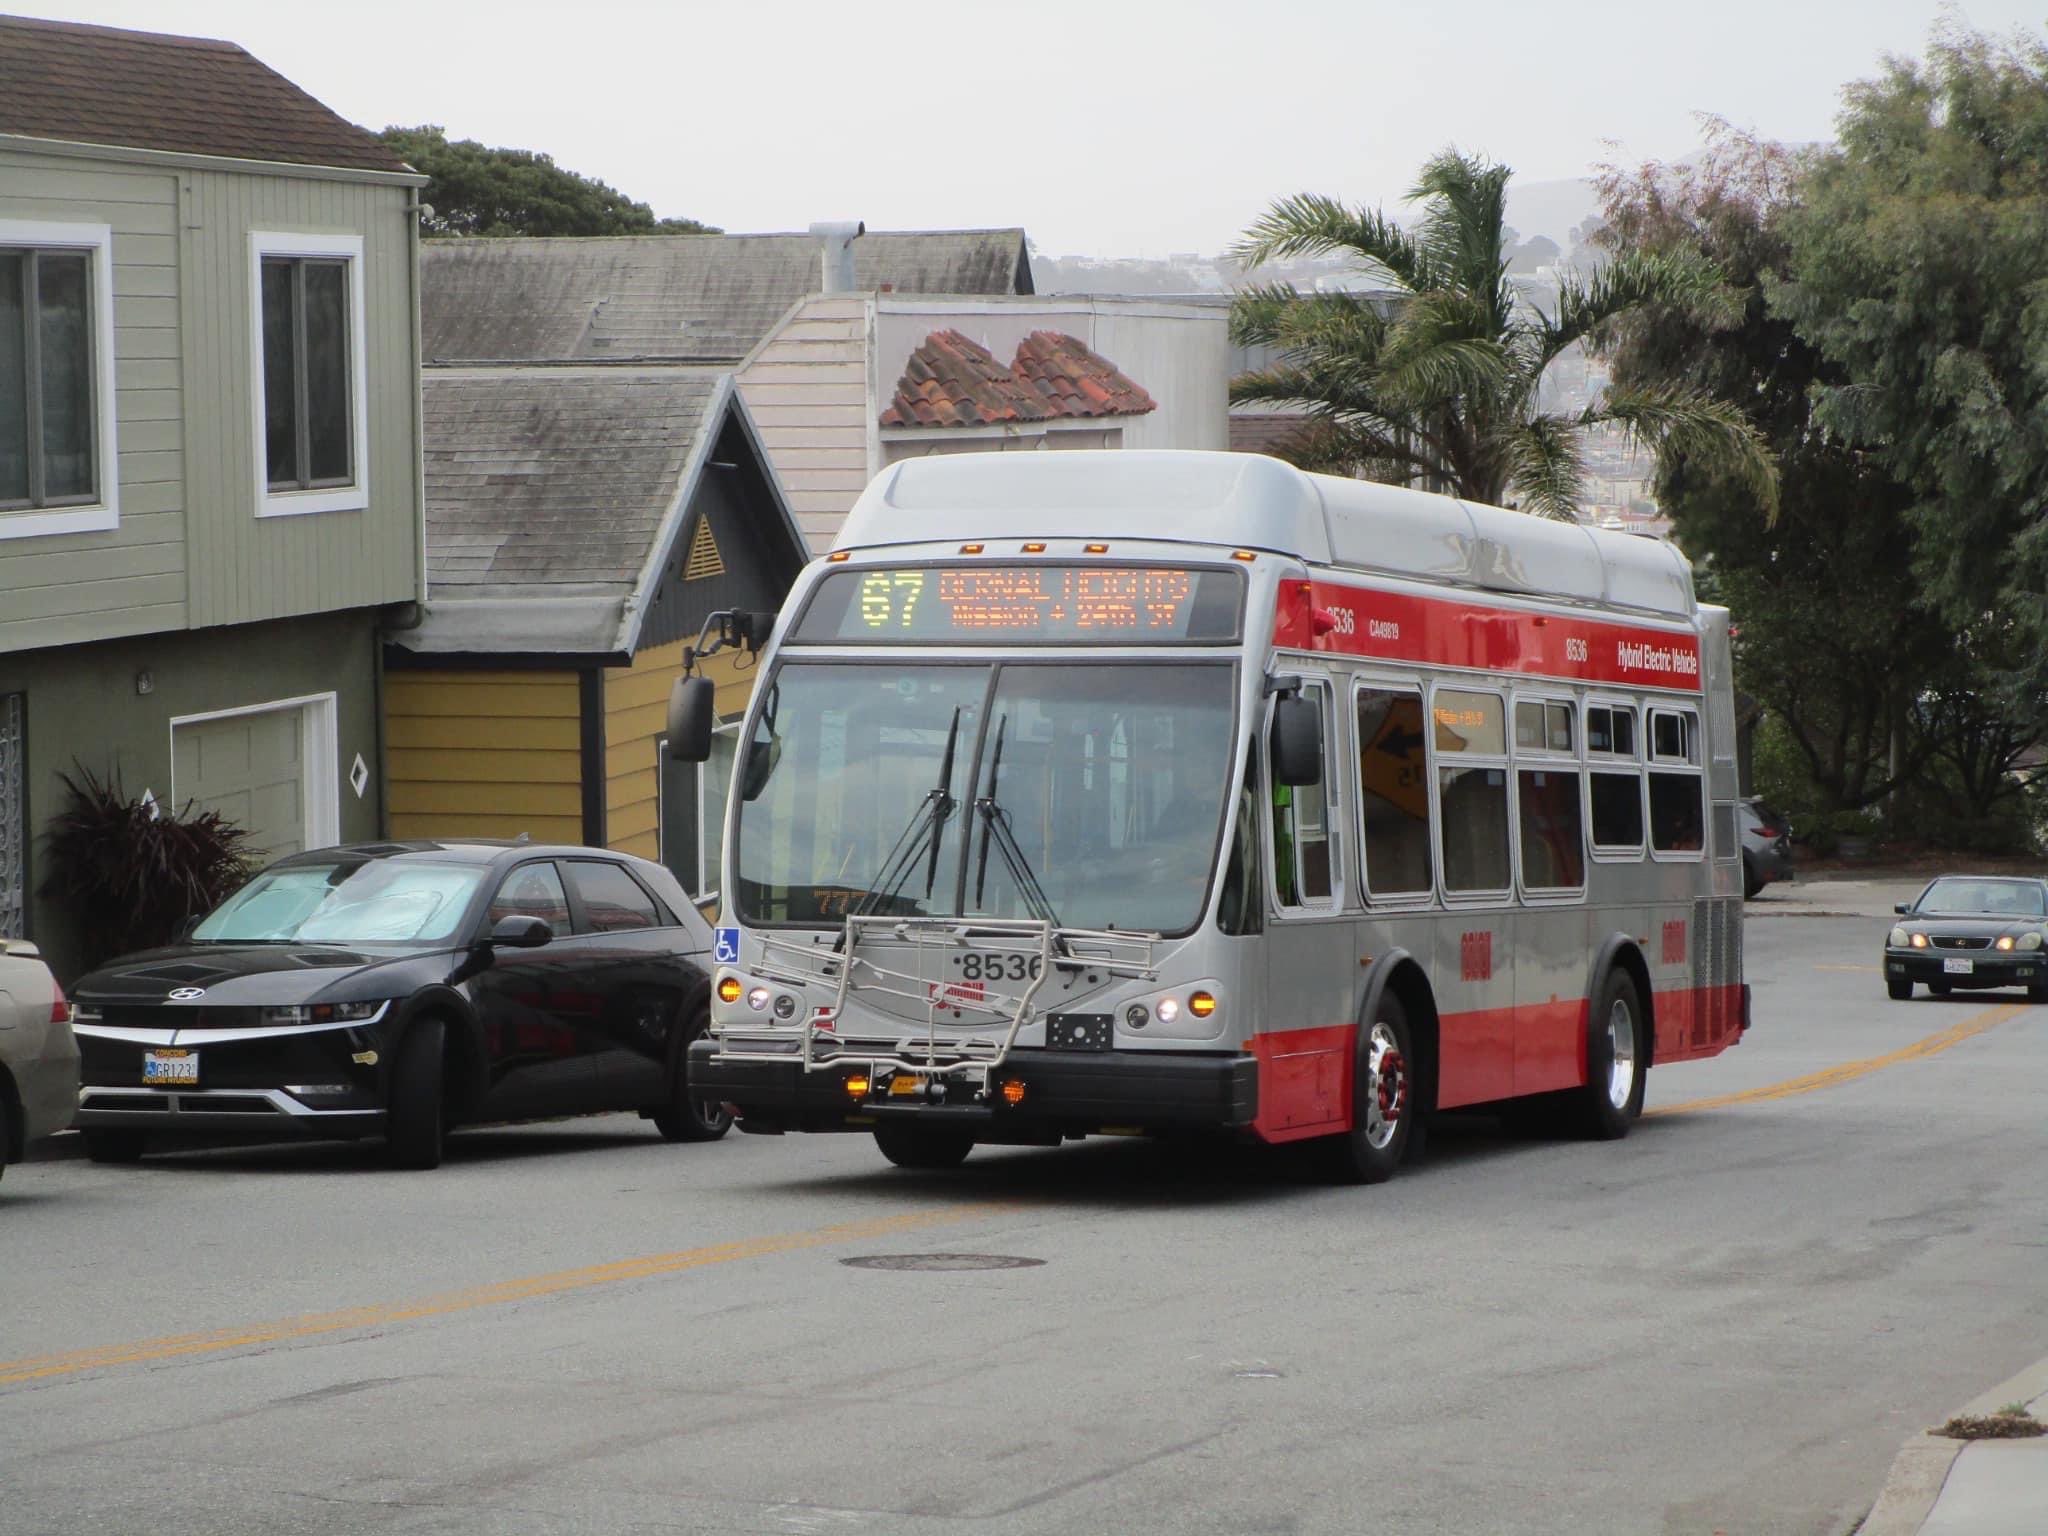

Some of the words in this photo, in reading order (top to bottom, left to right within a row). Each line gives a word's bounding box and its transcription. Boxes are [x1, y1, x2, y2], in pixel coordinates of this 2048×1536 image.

[862, 573, 923, 626] 67
[1566, 638, 1588, 662] 8536
[1618, 641, 1643, 672] Hybrid
[1644, 644, 1671, 672] Electric
[1672, 648, 1697, 674] Vehicle
[963, 953, 1042, 980] 8536
